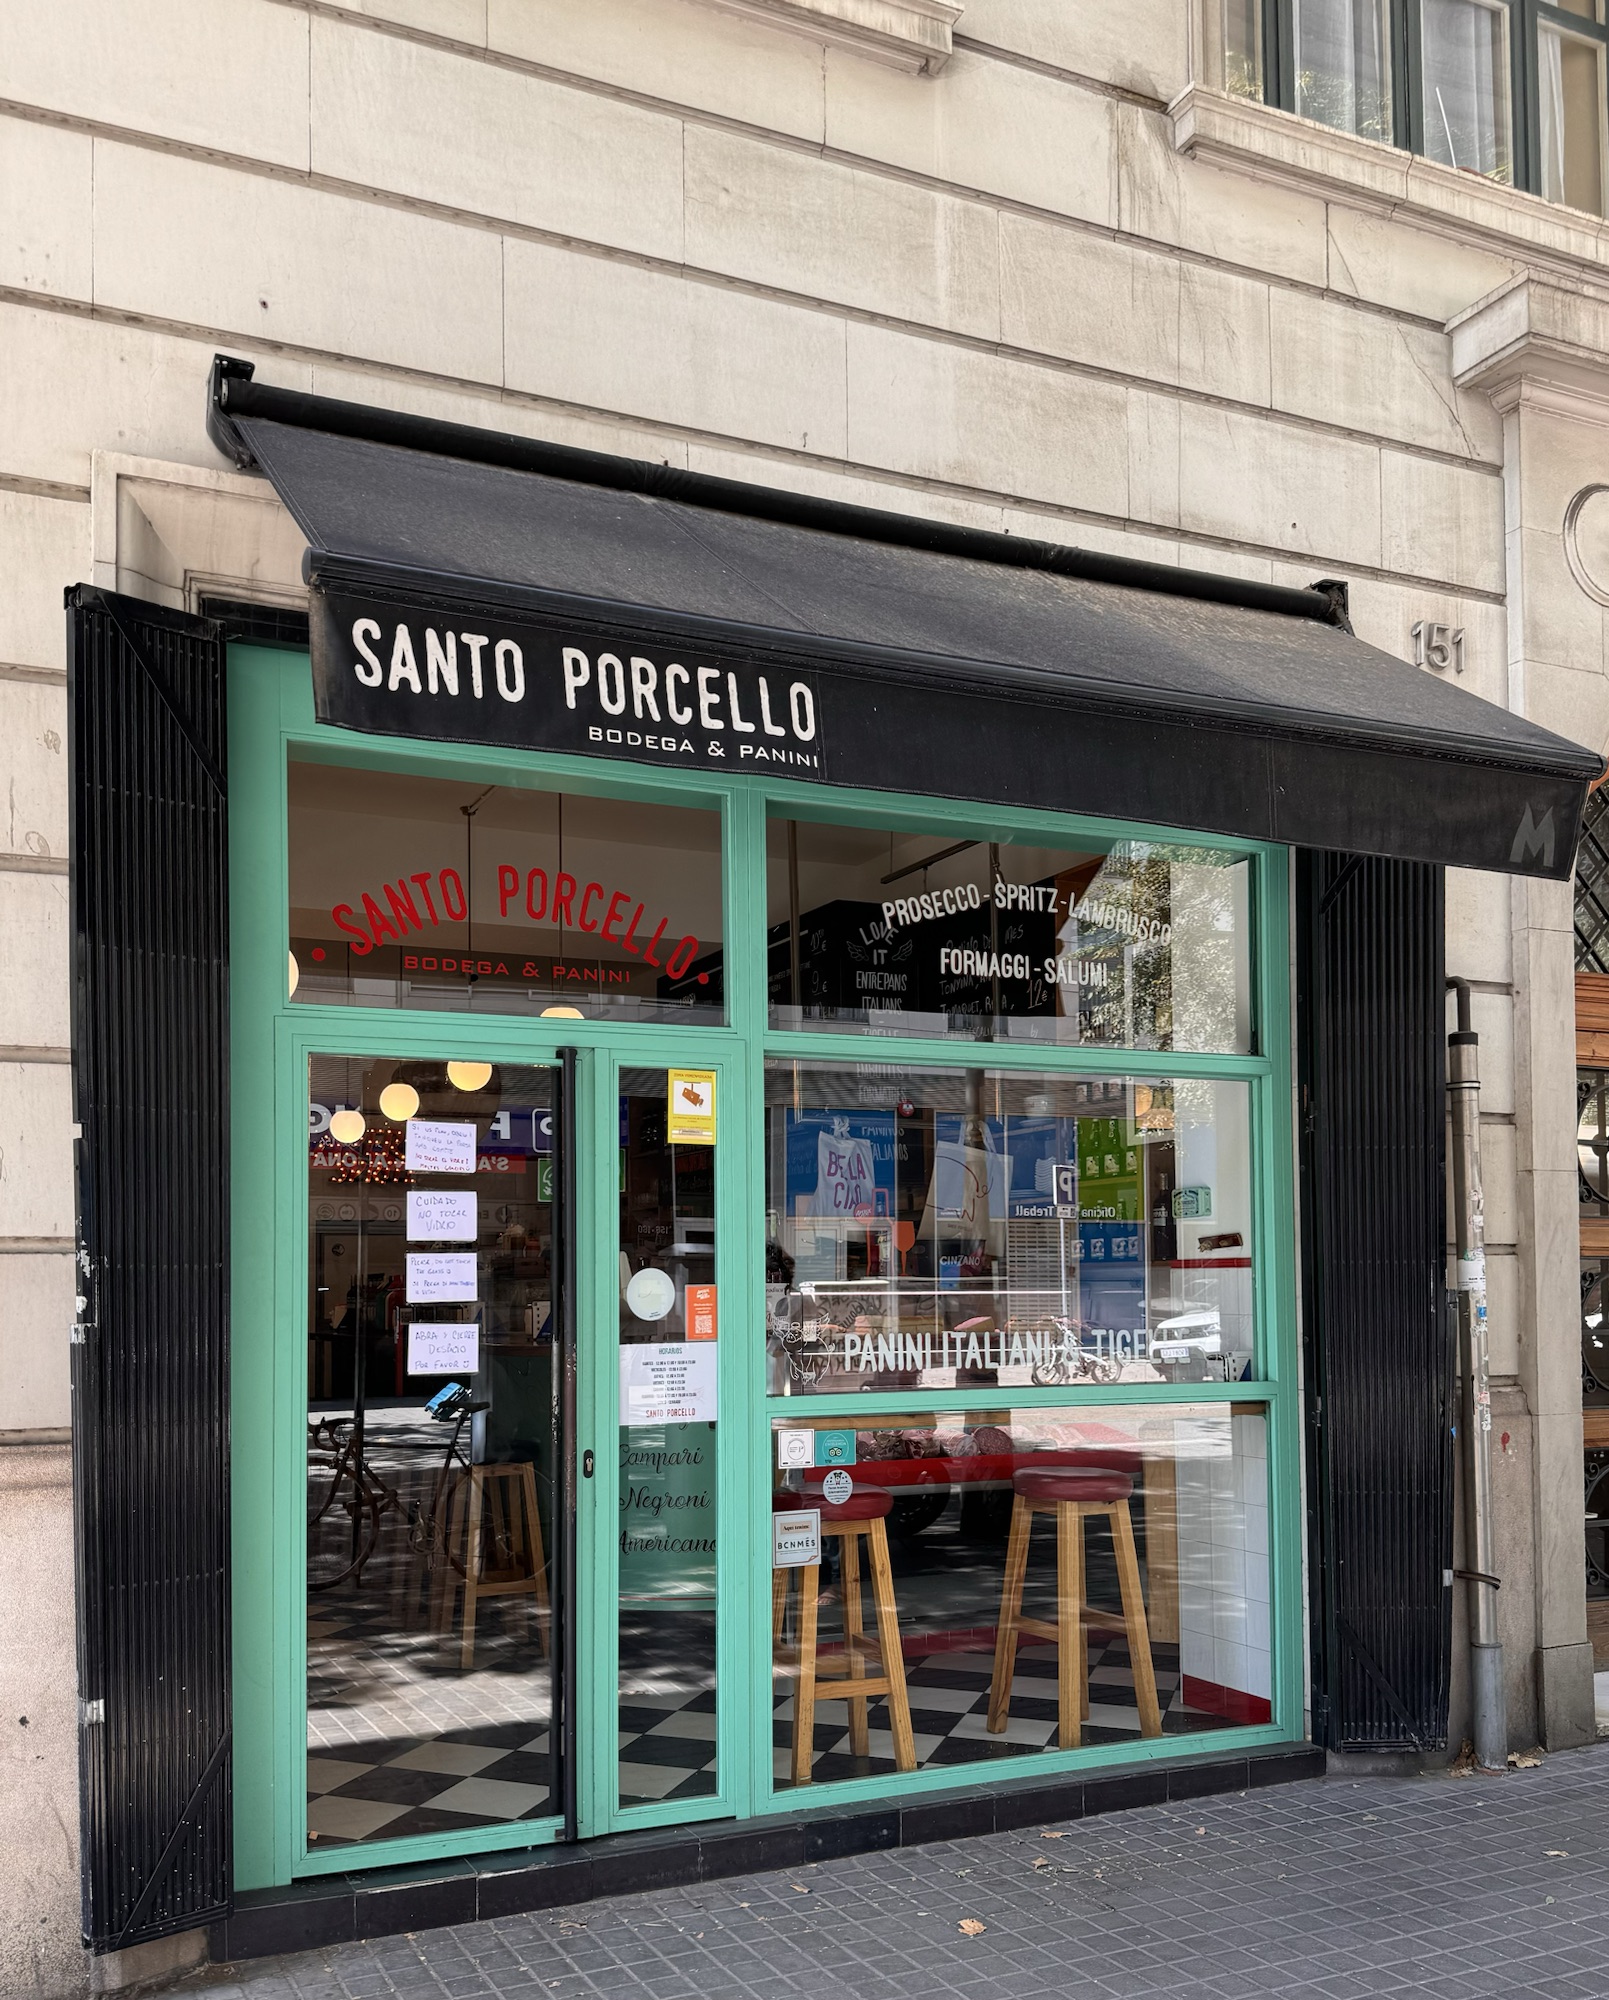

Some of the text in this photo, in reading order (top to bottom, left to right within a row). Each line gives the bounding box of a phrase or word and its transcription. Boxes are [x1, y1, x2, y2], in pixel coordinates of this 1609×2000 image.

[1411, 621, 1465, 674] 151
[351, 617, 817, 742] SANTO PORCELLO
[588, 725, 819, 768] BODEGA & PANINI
[881, 883, 981, 928] PROSECCO
[994, 883, 1058, 914] SPRITZ
[332, 864, 700, 981] SANTO PORCELLO
[859, 921, 899, 946] LOVE
[403, 955, 631, 983] BODEGA & PANINI
[873, 949, 888, 966] IT
[940, 948, 1030, 980] FORMAGGI
[1044, 956, 1109, 988] SALUMI
[856, 971, 908, 992] ENTREPANS
[862, 996, 903, 1016] ITALIANS
[939, 1254, 981, 1267] CINZANO
[845, 1332, 932, 1372] PANINI
[942, 1330, 1050, 1371] ITALIANI
[645, 1407, 696, 1418] SANTO PORCELLO
[619, 1443, 704, 1474] Campari
[619, 1485, 710, 1517] Negroni
[777, 1536, 816, 1550] BCNMÉS
